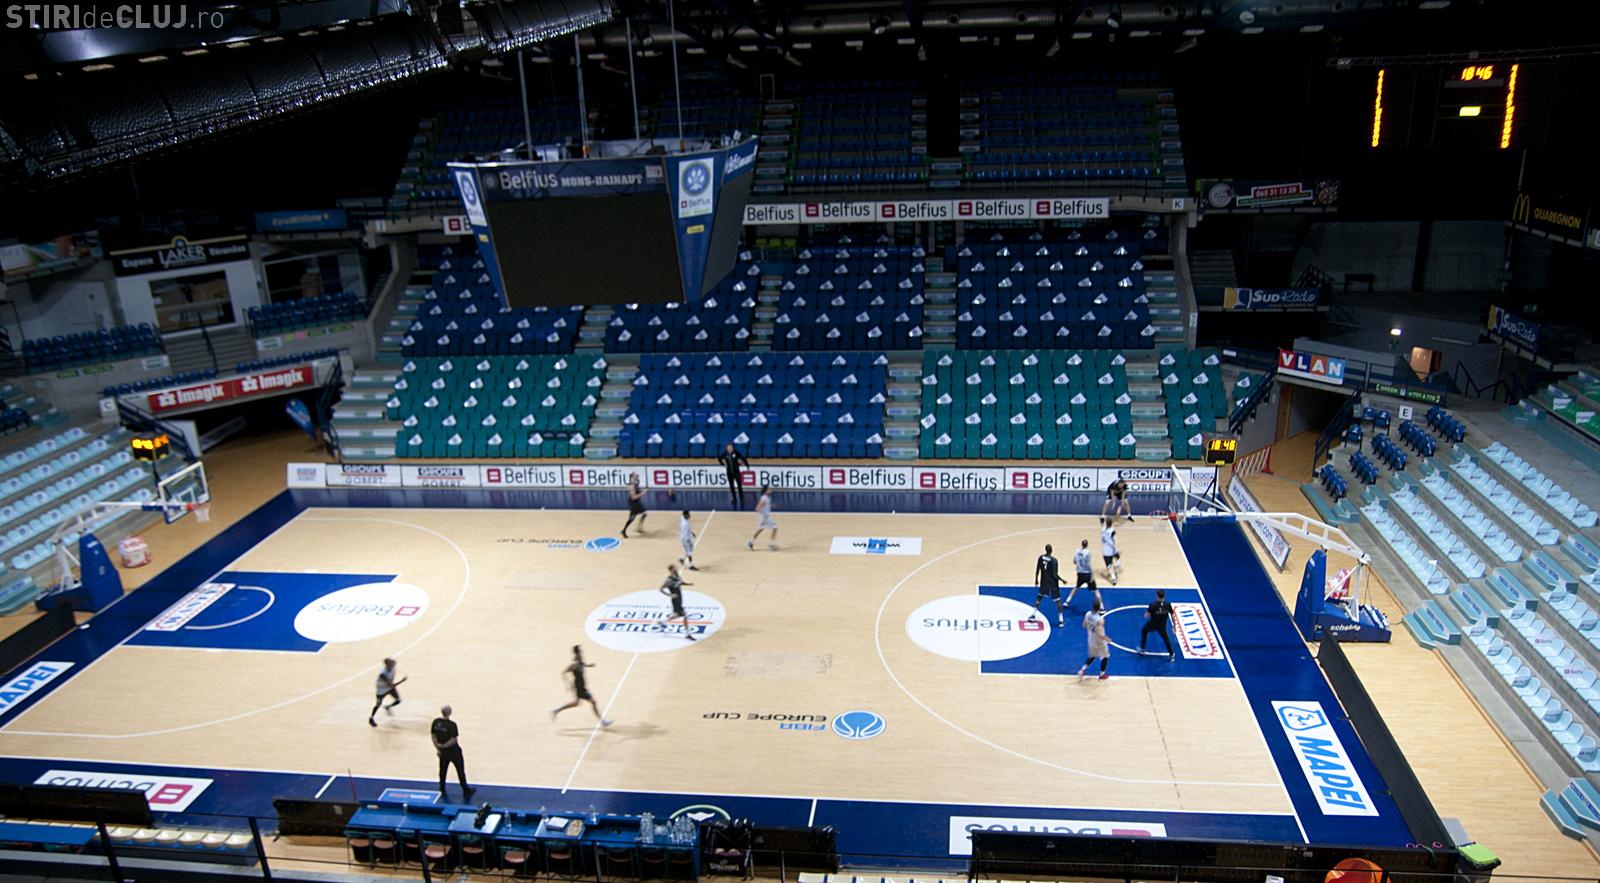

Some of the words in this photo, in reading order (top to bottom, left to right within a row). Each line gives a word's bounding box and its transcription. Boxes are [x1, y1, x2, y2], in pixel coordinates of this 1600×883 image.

[499, 171, 558, 190] Belfius
[561, 173, 644, 187] MONS-HAINAUT
[821, 202, 870, 218] Belfius
[898, 203, 947, 219] Belfius
[975, 200, 1025, 216] Belfius
[1053, 200, 1103, 216] Belfius
[1174, 201, 1182, 209] K
[747, 206, 795, 222] Belfius
[1533, 207, 1582, 230] QUAREGNON
[1282, 352, 1342, 376] VLAN
[260, 369, 304, 390] Imagix
[178, 384, 225, 404] Imagix
[104, 401, 112, 410] C
[1403, 408, 1409, 418] E
[343, 464, 383, 473] GROUPE
[420, 468, 461, 476] GROUPE
[504, 468, 557, 484] Belfius
[1120, 470, 1168, 479] GROUPE
[587, 469, 640, 486] Belfiu
[672, 469, 727, 486] Belfius
[760, 471, 816, 488] Belfius
[849, 469, 906, 486] Belfius
[940, 472, 998, 490] Belfius
[1033, 471, 1091, 489] Belfius
[319, 603, 394, 617] Belfius
[615, 611, 704, 620] GBERT
[922, 617, 1012, 631] Belfius
[703, 711, 741, 720] CUP
[748, 713, 827, 722] EUROPE
[779, 722, 827, 731] FIBA
[1295, 735, 1367, 810] MAPEI
